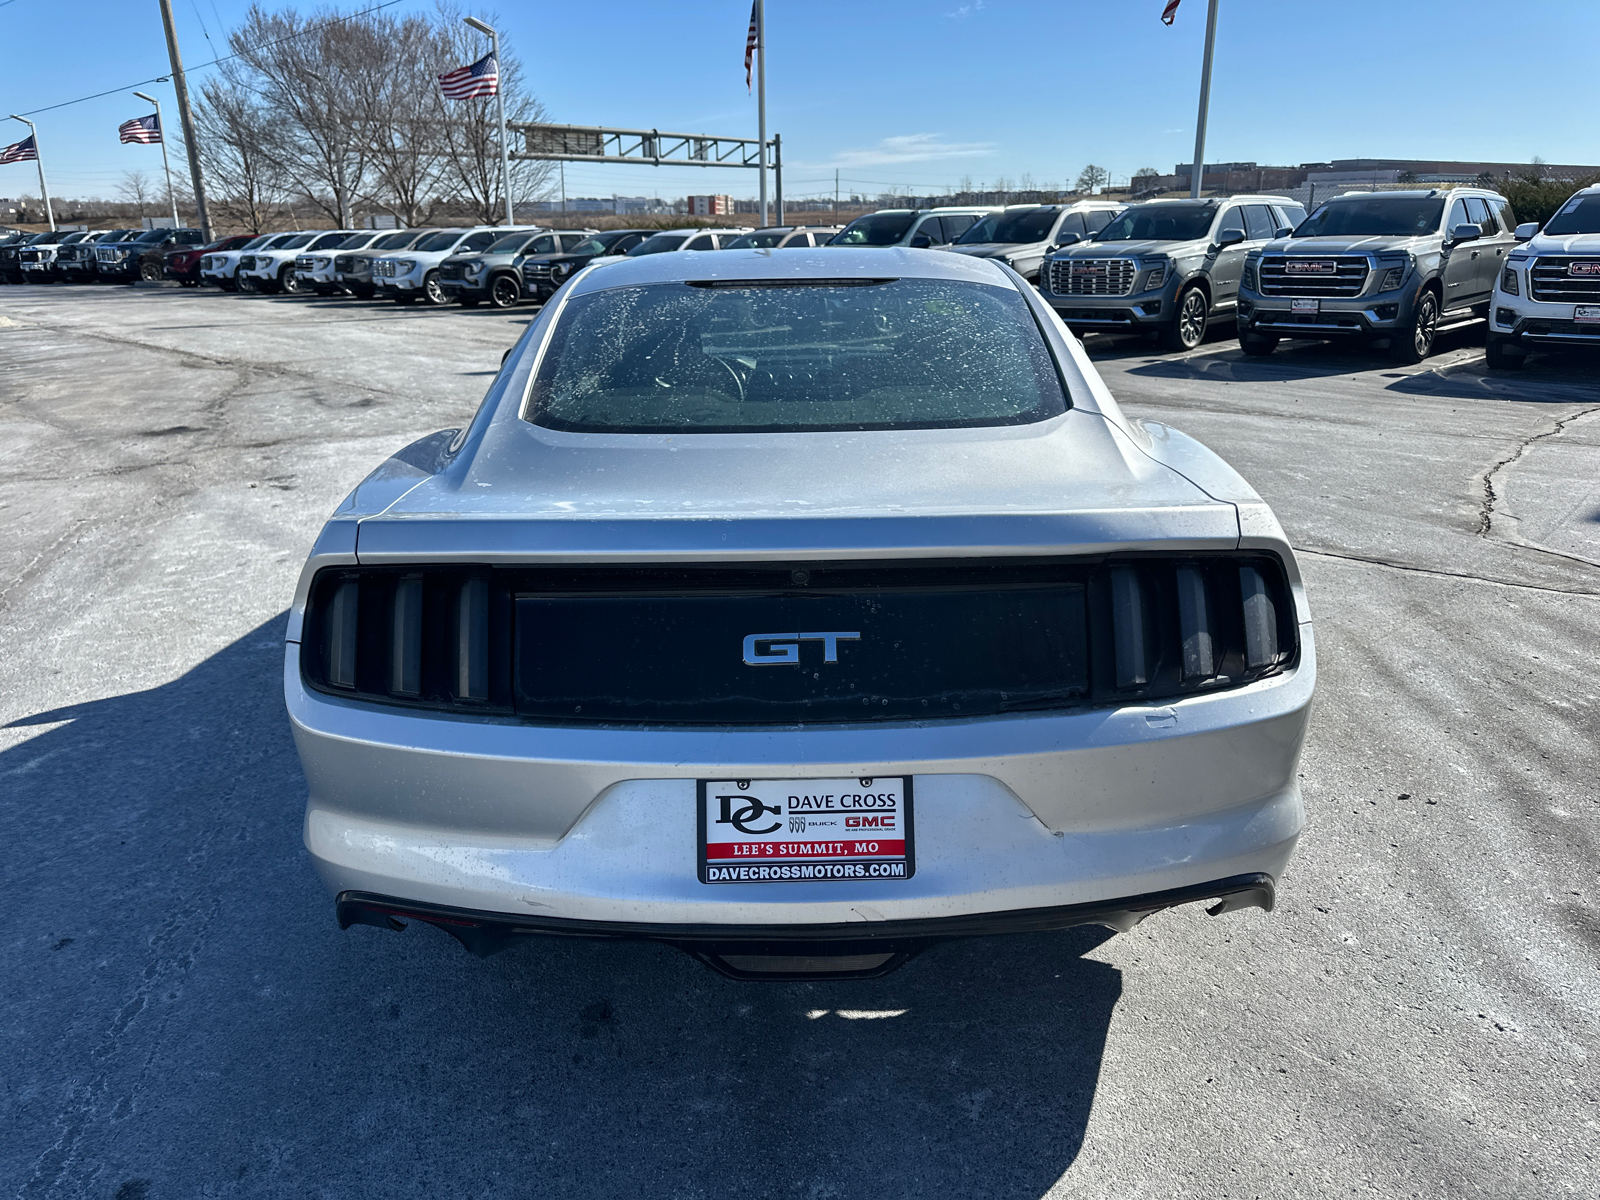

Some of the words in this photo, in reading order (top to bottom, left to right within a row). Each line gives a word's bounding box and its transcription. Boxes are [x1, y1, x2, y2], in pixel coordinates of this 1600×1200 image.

[1072, 266, 1105, 274] GMC
[1288, 262, 1332, 272] GMC
[1573, 263, 1600, 274] GM
[743, 631, 861, 666] GT
[788, 795, 834, 809] DAVE
[840, 793, 896, 808] CROSS
[715, 795, 783, 835] DC
[845, 816, 896, 827] GMC
[733, 844, 774, 856] LEE'S
[779, 842, 848, 856] SUMMIT,
[854, 842, 879, 854] MO
[709, 863, 904, 881] DAVECROSSMOTORS.COM
